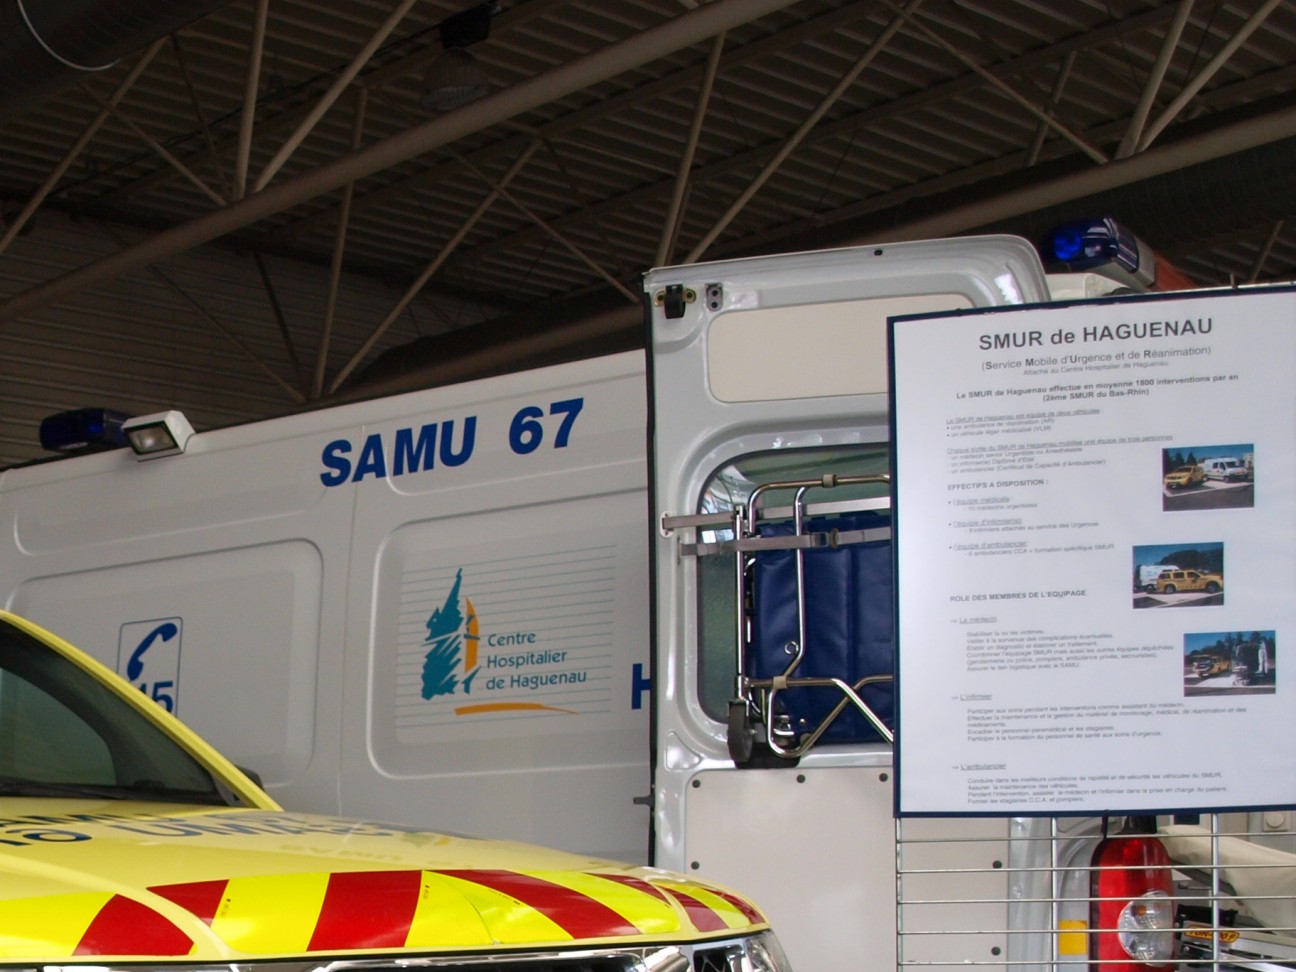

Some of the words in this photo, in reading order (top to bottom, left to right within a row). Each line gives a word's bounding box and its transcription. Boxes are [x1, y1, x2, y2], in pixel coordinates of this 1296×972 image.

[979, 330, 1043, 349] SMUR
[1051, 328, 1075, 345] de
[1083, 319, 1212, 342] HAGUENAU
[982, 360, 1022, 373] (Service
[1025, 358, 1058, 368] Mobile
[1061, 354, 1112, 368] d'Urgence
[1115, 353, 1125, 362] et
[1127, 352, 1140, 361] de
[1144, 347, 1211, 362] Réanimation)
[957, 391, 966, 399] Le
[968, 390, 992, 398] SMUR
[1007, 386, 1047, 397] Haguenau
[1049, 384, 1081, 393] effectue
[1096, 382, 1133, 392] moyenne
[1156, 376, 1210, 386] interventions
[1213, 376, 1226, 384] par
[1043, 394, 1067, 404] (2ème
[1070, 392, 1094, 400] SMUR
[1109, 388, 1149, 399] Bas-Rhin)
[319, 415, 478, 487] SAMU
[507, 397, 584, 455] 67
[947, 482, 987, 491] EFFECTIFS
[997, 479, 1044, 488] DISPOSITION
[989, 593, 1026, 601] MEMBRES
[1041, 590, 1086, 599] L'EQUIPAGE
[487, 632, 536, 648] Centre
[487, 650, 568, 669] Hospitalier
[486, 677, 505, 690] de
[510, 671, 587, 690] Haguenau
